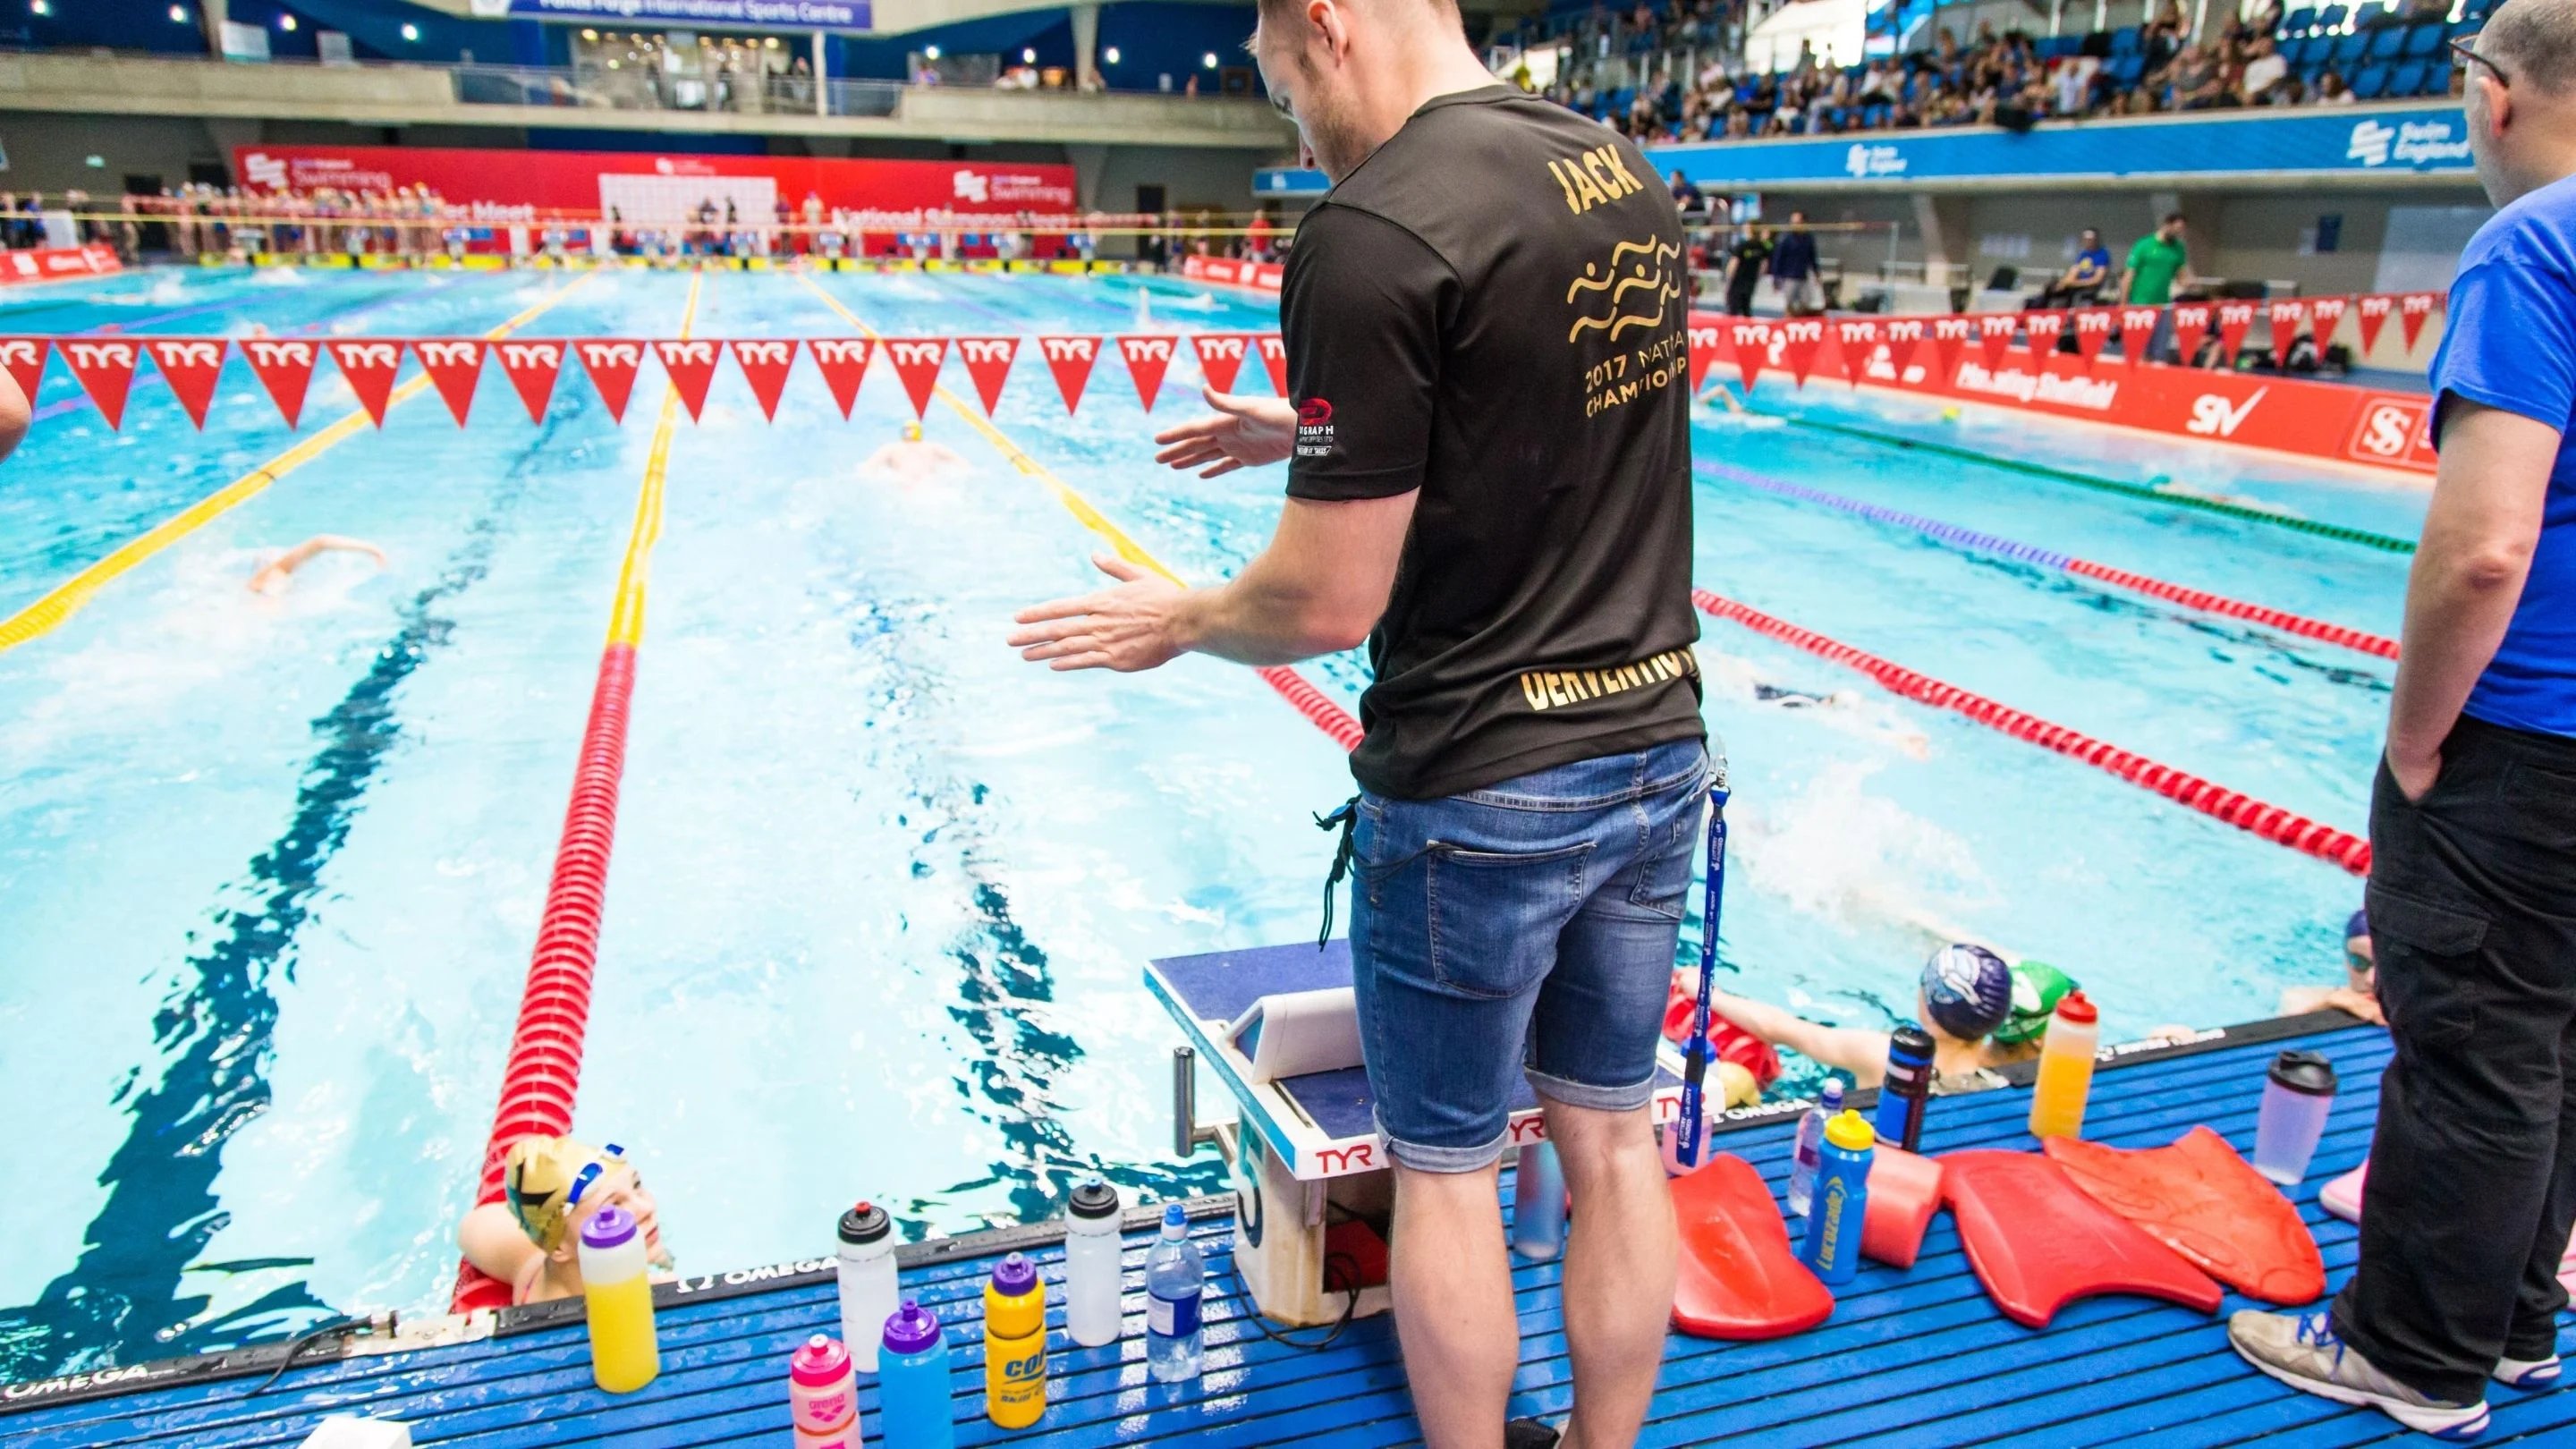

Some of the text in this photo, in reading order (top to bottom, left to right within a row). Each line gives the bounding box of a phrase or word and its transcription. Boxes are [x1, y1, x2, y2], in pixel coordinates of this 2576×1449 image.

[745, 2, 797, 22] Sports
[799, 4, 852, 24] Centre
[1547, 144, 1643, 215] JACK
[0, 341, 38, 366] YR
[70, 344, 132, 368] TYR
[157, 343, 219, 367] TYR
[250, 343, 310, 366] TYR
[338, 344, 396, 368] TYR
[419, 342, 477, 366] TYR
[503, 344, 559, 369] TYR
[583, 343, 639, 368] TYR
[659, 342, 712, 365] TYR
[736, 342, 788, 364] TYR
[815, 341, 865, 365] TYR
[892, 343, 940, 366] TYR
[962, 340, 1011, 362] TYR
[1045, 339, 1092, 361] TYR
[1124, 339, 1171, 361] TYR
[1199, 338, 1244, 360] TYR
[1262, 338, 1285, 359] TY
[1586, 355, 1626, 393] 2017
[1725, 1097, 1814, 1120] OMEGA
[1510, 1116, 1546, 1141] YR
[1316, 1144, 1373, 1174] TYR
[724, 1256, 840, 1284] OMEGA
[4, 1364, 148, 1398] OMEGA
[809, 1394, 844, 1410] arena
